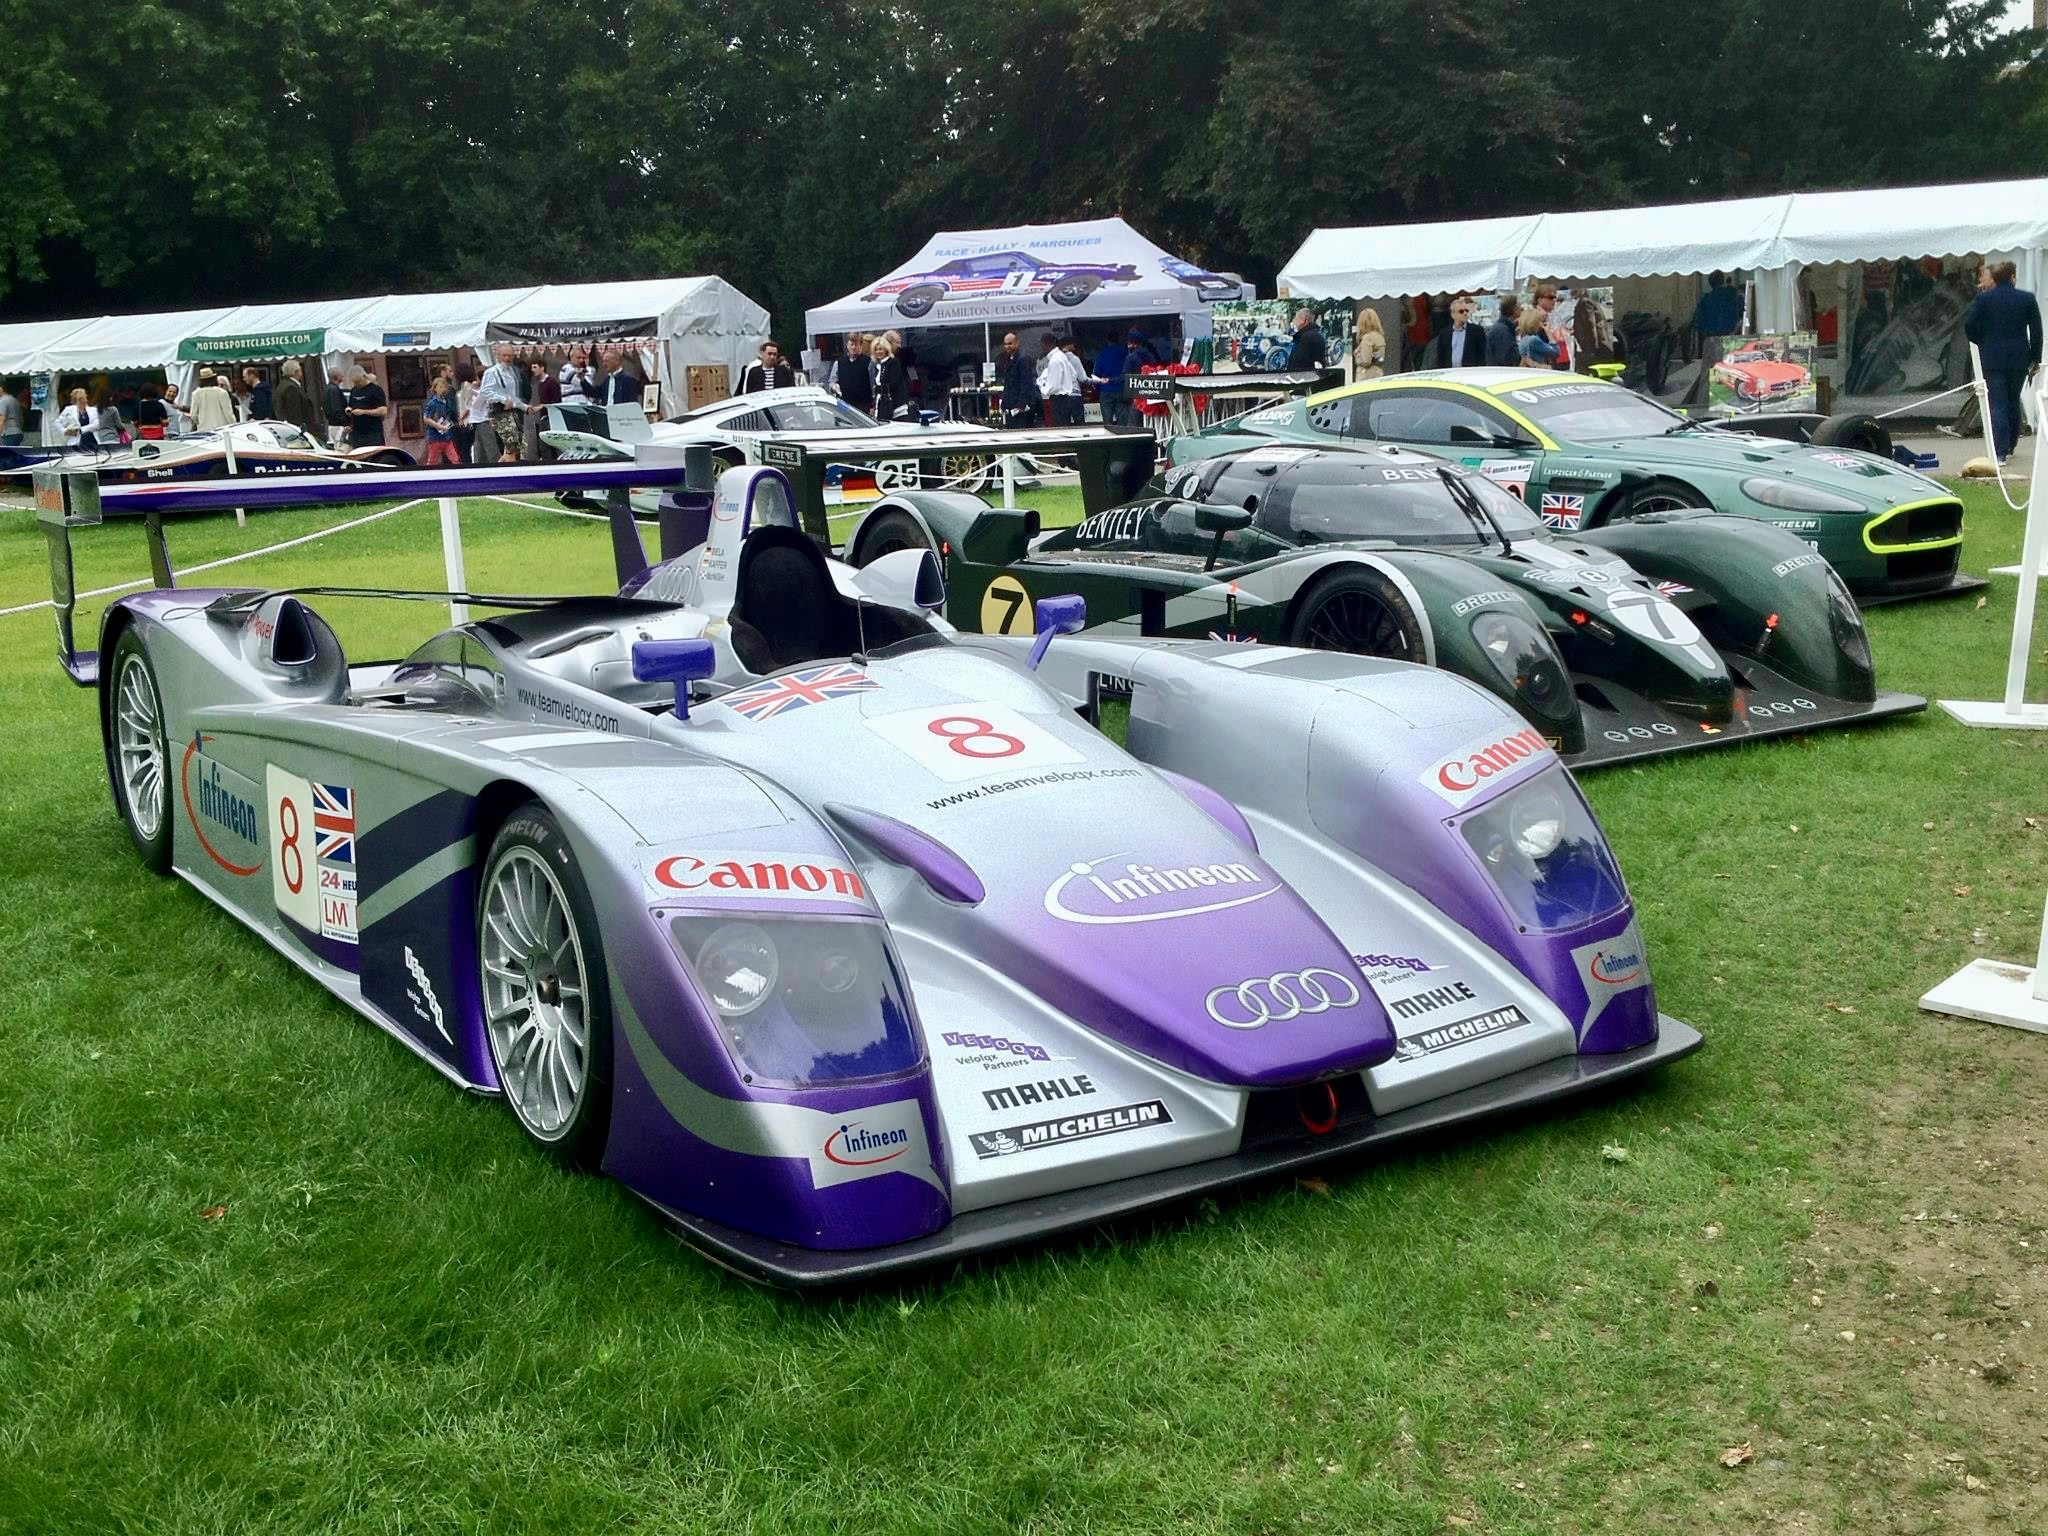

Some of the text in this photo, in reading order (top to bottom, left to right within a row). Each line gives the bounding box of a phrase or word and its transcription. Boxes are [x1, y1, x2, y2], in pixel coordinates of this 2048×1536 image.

[934, 237, 1103, 257] RACE RALLY MARQUEES
[1012, 273, 1024, 287] 1
[937, 303, 1038, 319] HAMILTON CLASSIC
[195, 334, 312, 350] MOTORSPORTCLASSICS.COM
[1129, 378, 1170, 389] HACKETT
[148, 468, 173, 477] Shell
[882, 462, 918, 489] 25
[1584, 470, 1613, 479] PARTNER
[1076, 506, 1149, 540] BENTLEY
[990, 586, 1024, 635] 7
[1611, 596, 1676, 640] 7
[517, 687, 619, 734] www.teamveloqx.com
[927, 716, 1026, 759] 8
[1438, 729, 1550, 791] Canon
[197, 738, 259, 846] Infineon
[926, 765, 1142, 811] www.teamveloqx.com
[279, 796, 303, 895] 8
[320, 869, 340, 889] 24
[654, 855, 865, 900] Canon
[1088, 857, 1262, 904] Infineon
[324, 898, 349, 928] LM
[1353, 955, 1429, 971] ELOQX
[1381, 971, 1416, 985] Partners
[1600, 952, 1640, 975] Infineon
[1390, 981, 1477, 1018] MAHLE
[1423, 1004, 1521, 1050] MICHELIN
[943, 1033, 1048, 1060] VELOQX
[983, 1058, 1030, 1071] Partners
[982, 1074, 1096, 1111] MAHLE
[1021, 1099, 1161, 1145] MICHELIN
[842, 1124, 908, 1154] Infineon
